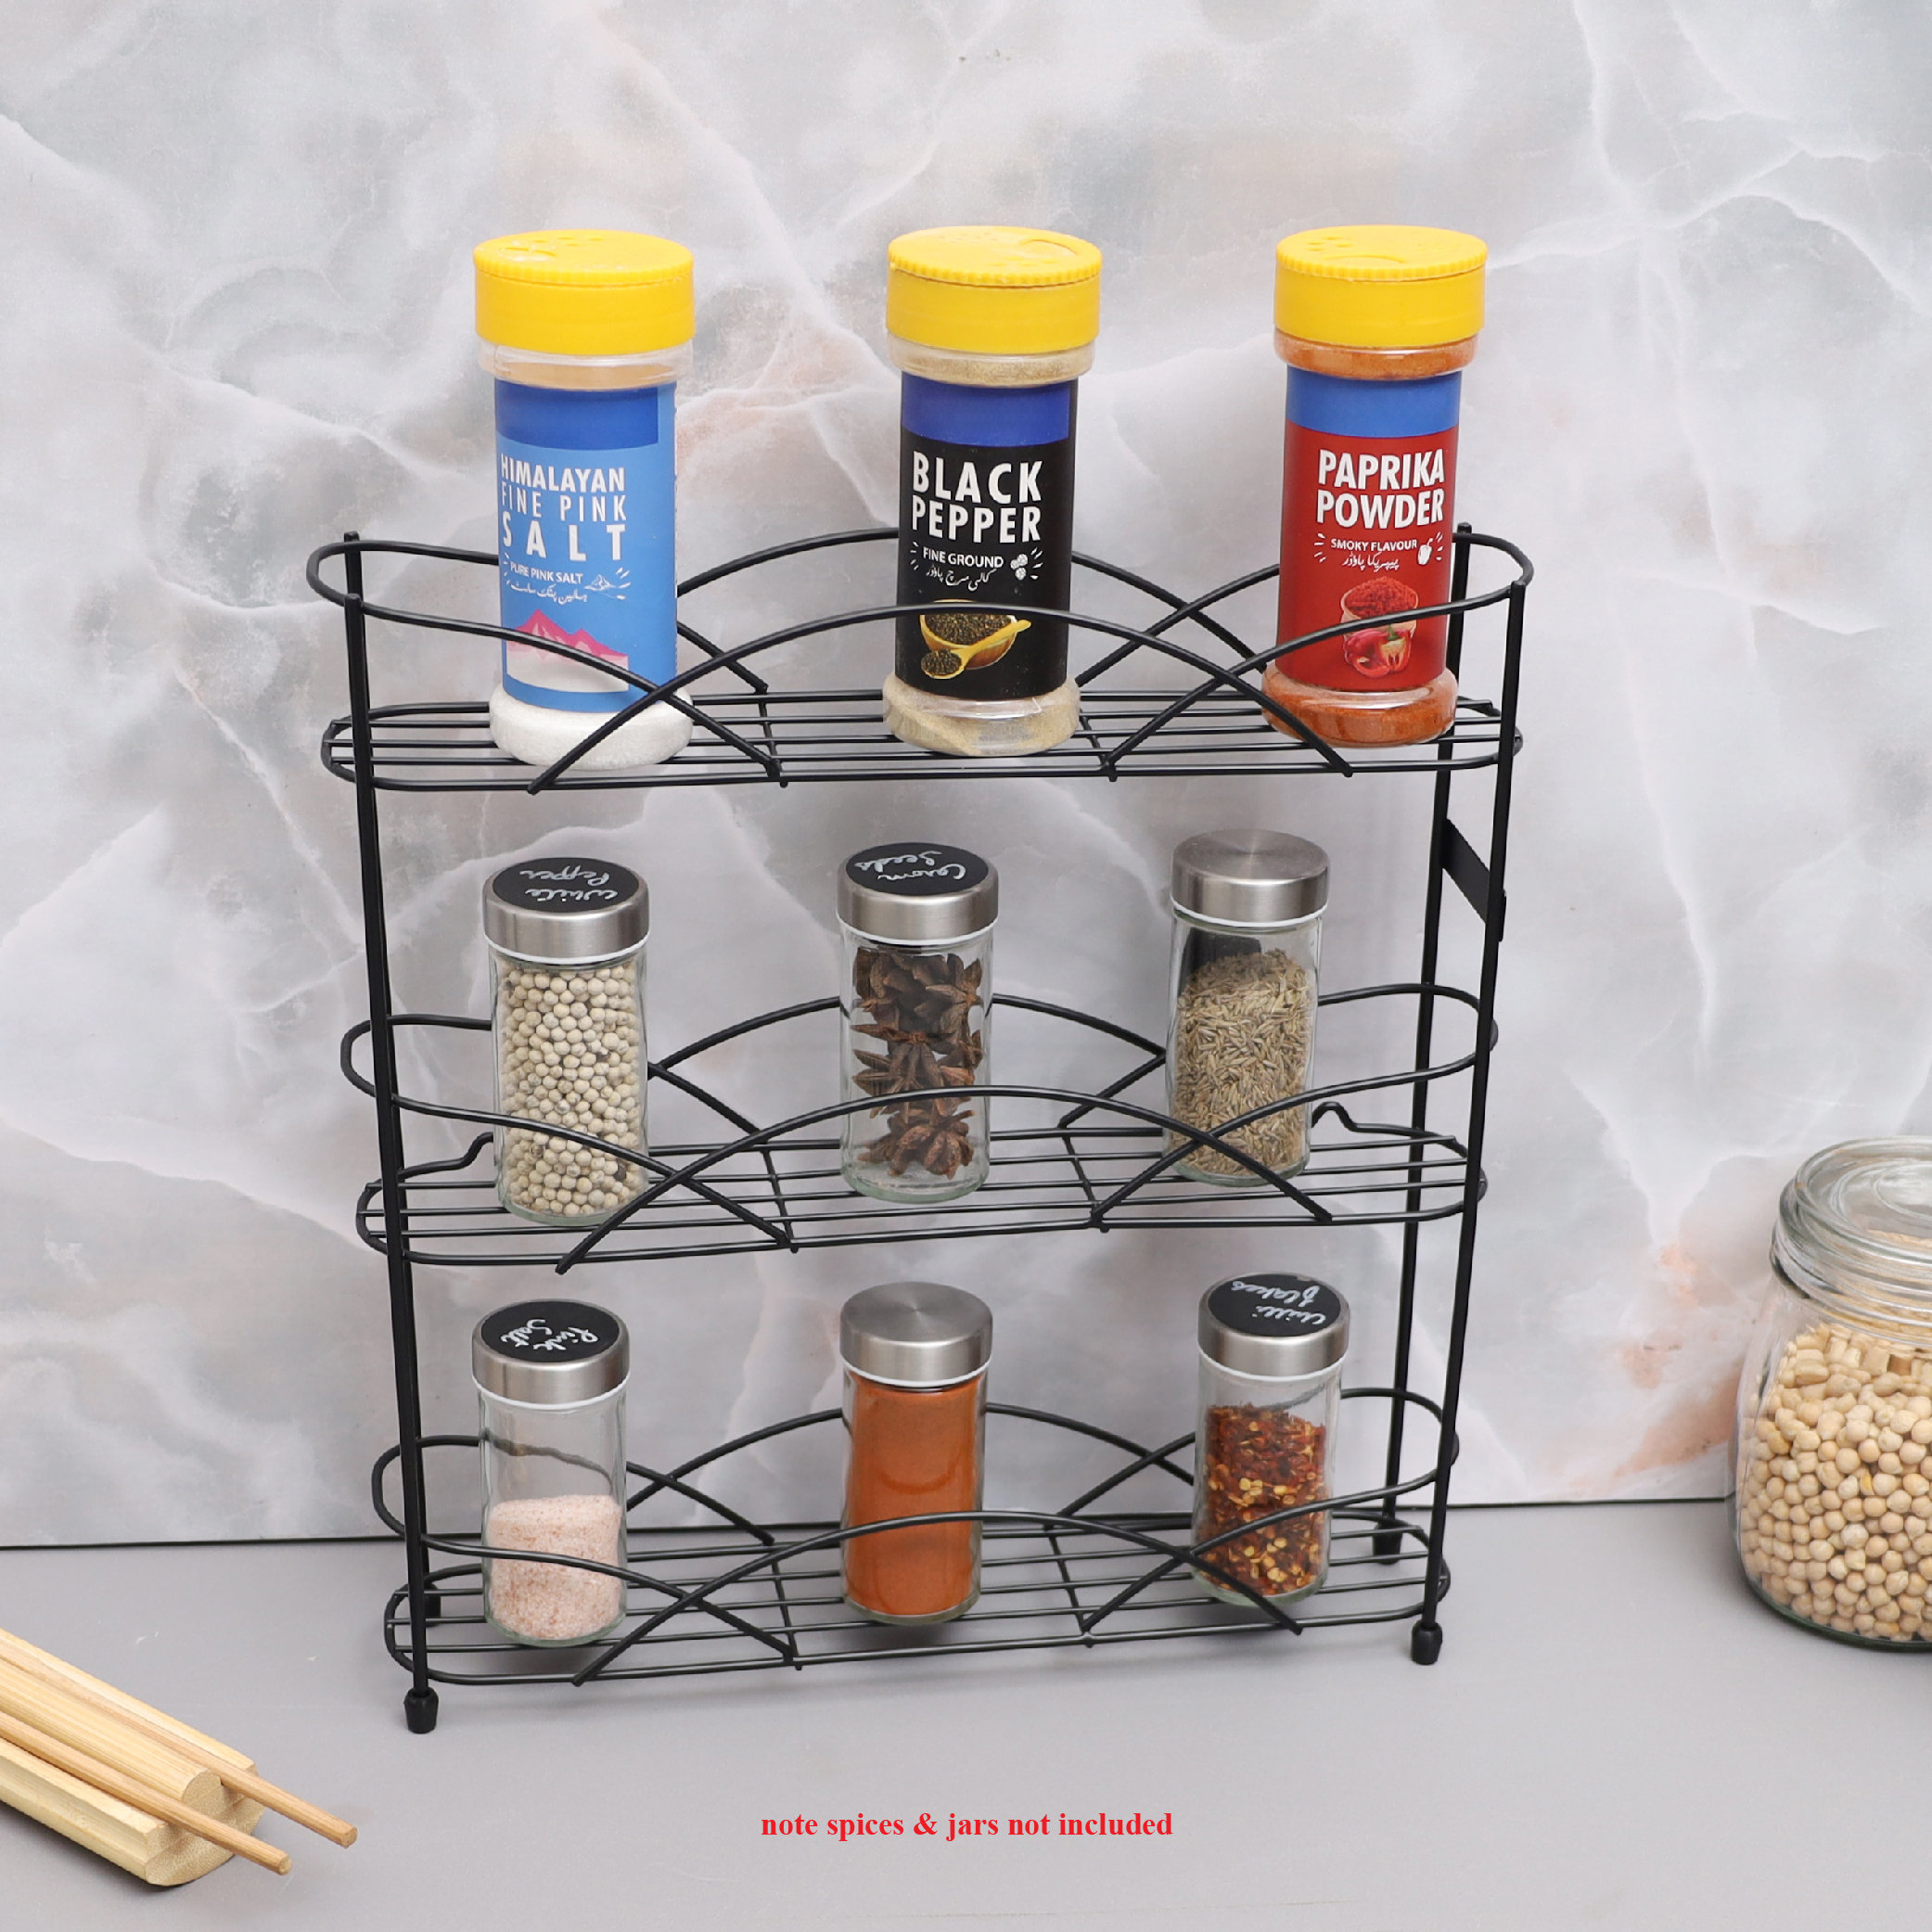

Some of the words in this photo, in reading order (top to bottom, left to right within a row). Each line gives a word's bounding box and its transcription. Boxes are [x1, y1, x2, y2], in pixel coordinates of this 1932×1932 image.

[501, 453, 626, 493] HIMALAYAN
[913, 450, 1043, 505] BLACK
[1318, 448, 1445, 490] PAPRIKA
[501, 481, 542, 518] FINE
[559, 494, 627, 522] PINK
[912, 494, 1042, 544] PEPPER
[1316, 488, 1445, 530] POWDER
[502, 511, 626, 562] SALT
[1330, 538, 1369, 551] SMOKY
[1370, 539, 1417, 552] FLAVOUR
[510, 562, 531, 579] PURE
[531, 568, 554, 582] PINK
[556, 571, 584, 585] SALT
[923, 546, 946, 563] FINE
[947, 553, 1004, 569] GROUND
[519, 865, 610, 887] Pepper
[525, 888, 619, 902] White
[532, 1326, 599, 1350] Pink
